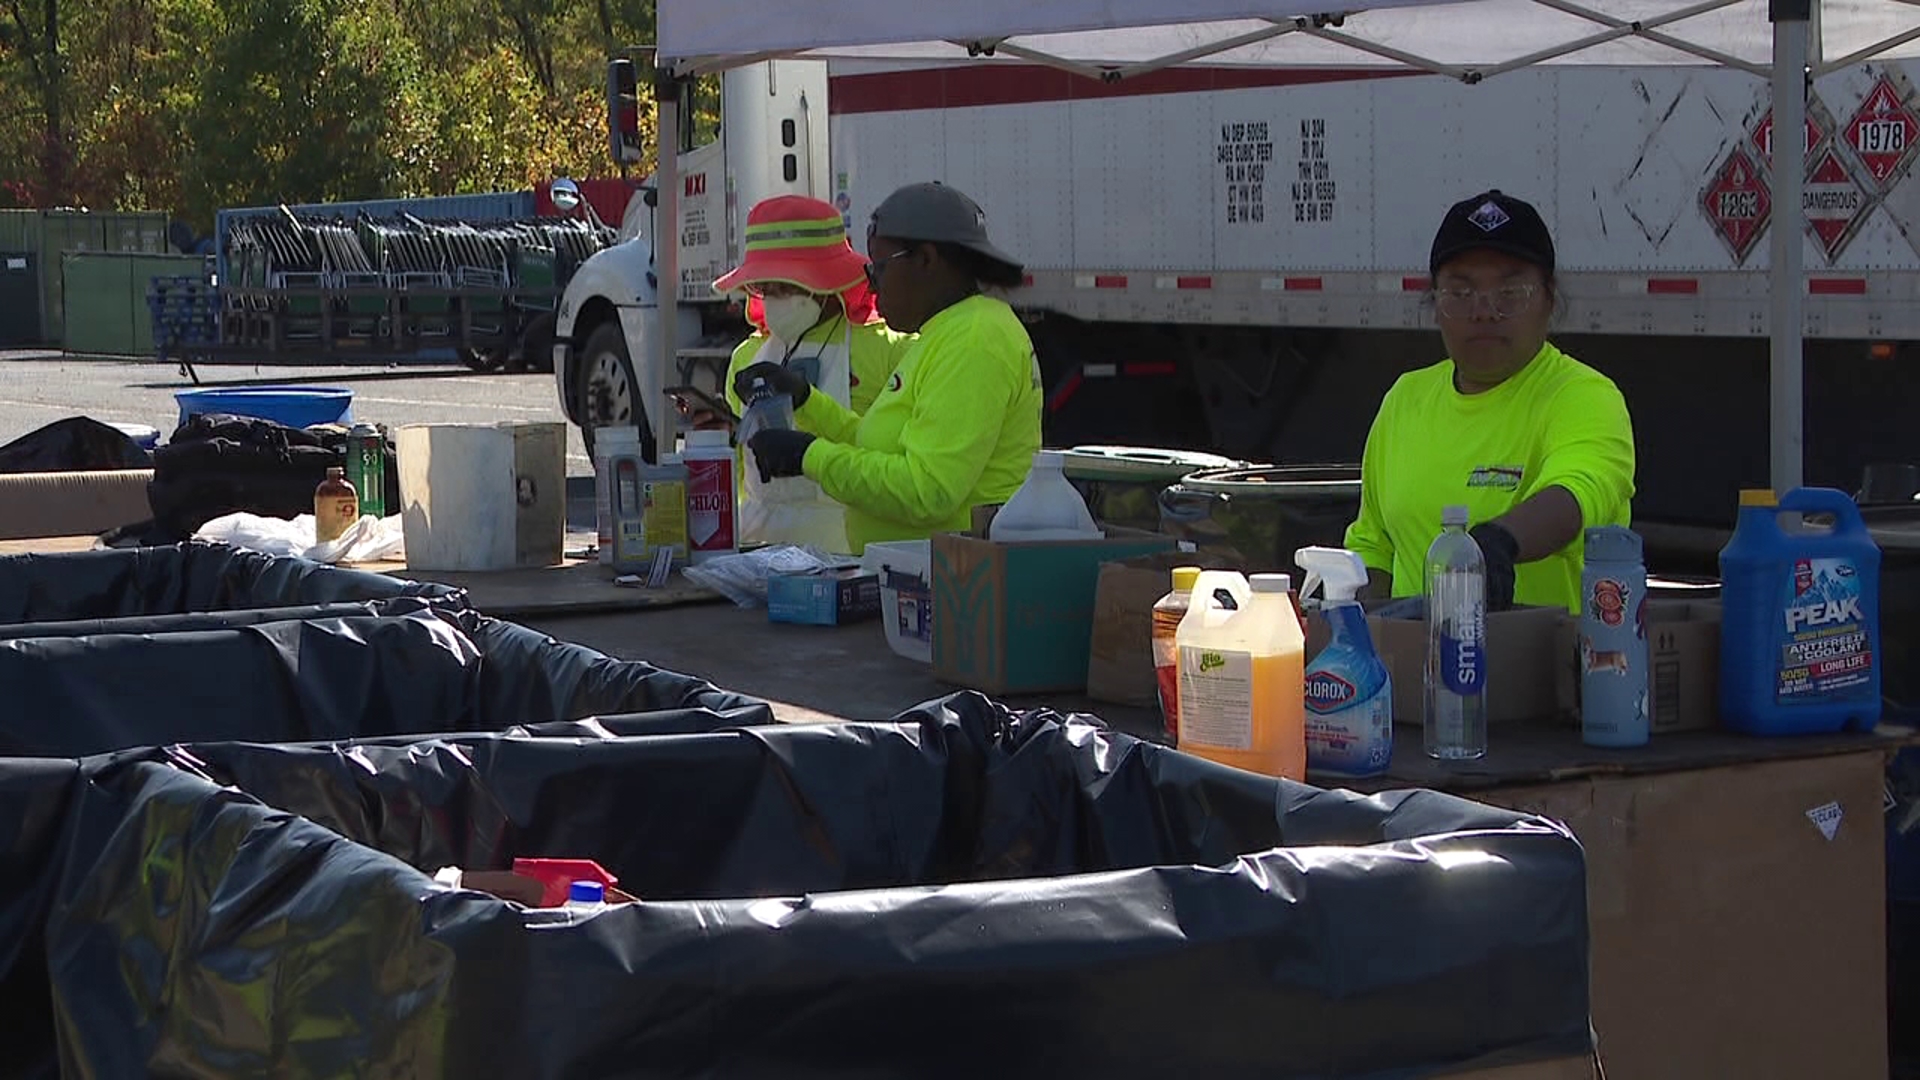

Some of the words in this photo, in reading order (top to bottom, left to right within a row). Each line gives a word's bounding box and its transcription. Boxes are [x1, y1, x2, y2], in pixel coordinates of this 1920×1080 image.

[1861, 123, 1903, 151] 1978
[1235, 143, 1255, 163] CUBIC
[1256, 142, 1273, 162] FEET
[1876, 163, 1884, 178] 2
[1803, 191, 1858, 210] DANGEROUS
[1785, 597, 1865, 634] PEAK
[1790, 632, 1866, 654] ANTIFREEZE
[1820, 660, 1845, 673] LONG
[1846, 656, 1865, 668] LIFE
[1304, 681, 1346, 699] CLOROX
